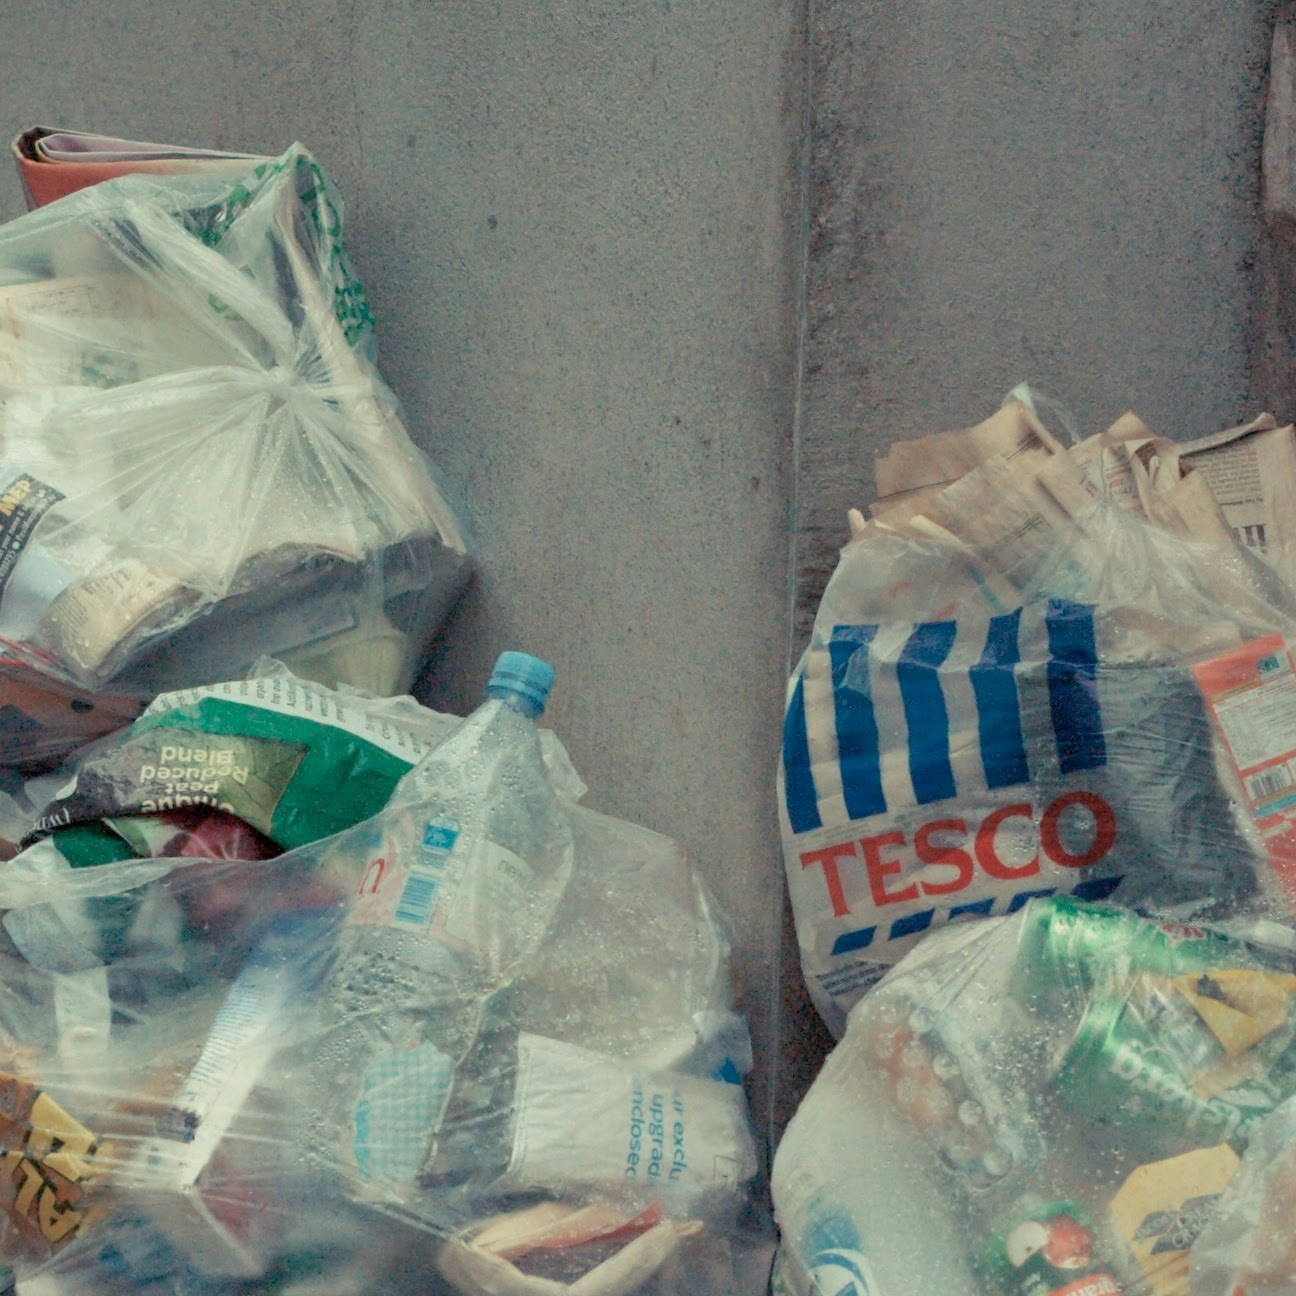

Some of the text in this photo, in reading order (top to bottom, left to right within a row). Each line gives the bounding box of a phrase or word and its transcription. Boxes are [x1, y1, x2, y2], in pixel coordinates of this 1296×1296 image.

[140, 763, 249, 785] Reduced
[160, 746, 234, 766] Blend
[799, 790, 1117, 918] TESCO
[647, 1092, 665, 1180] upgrad
